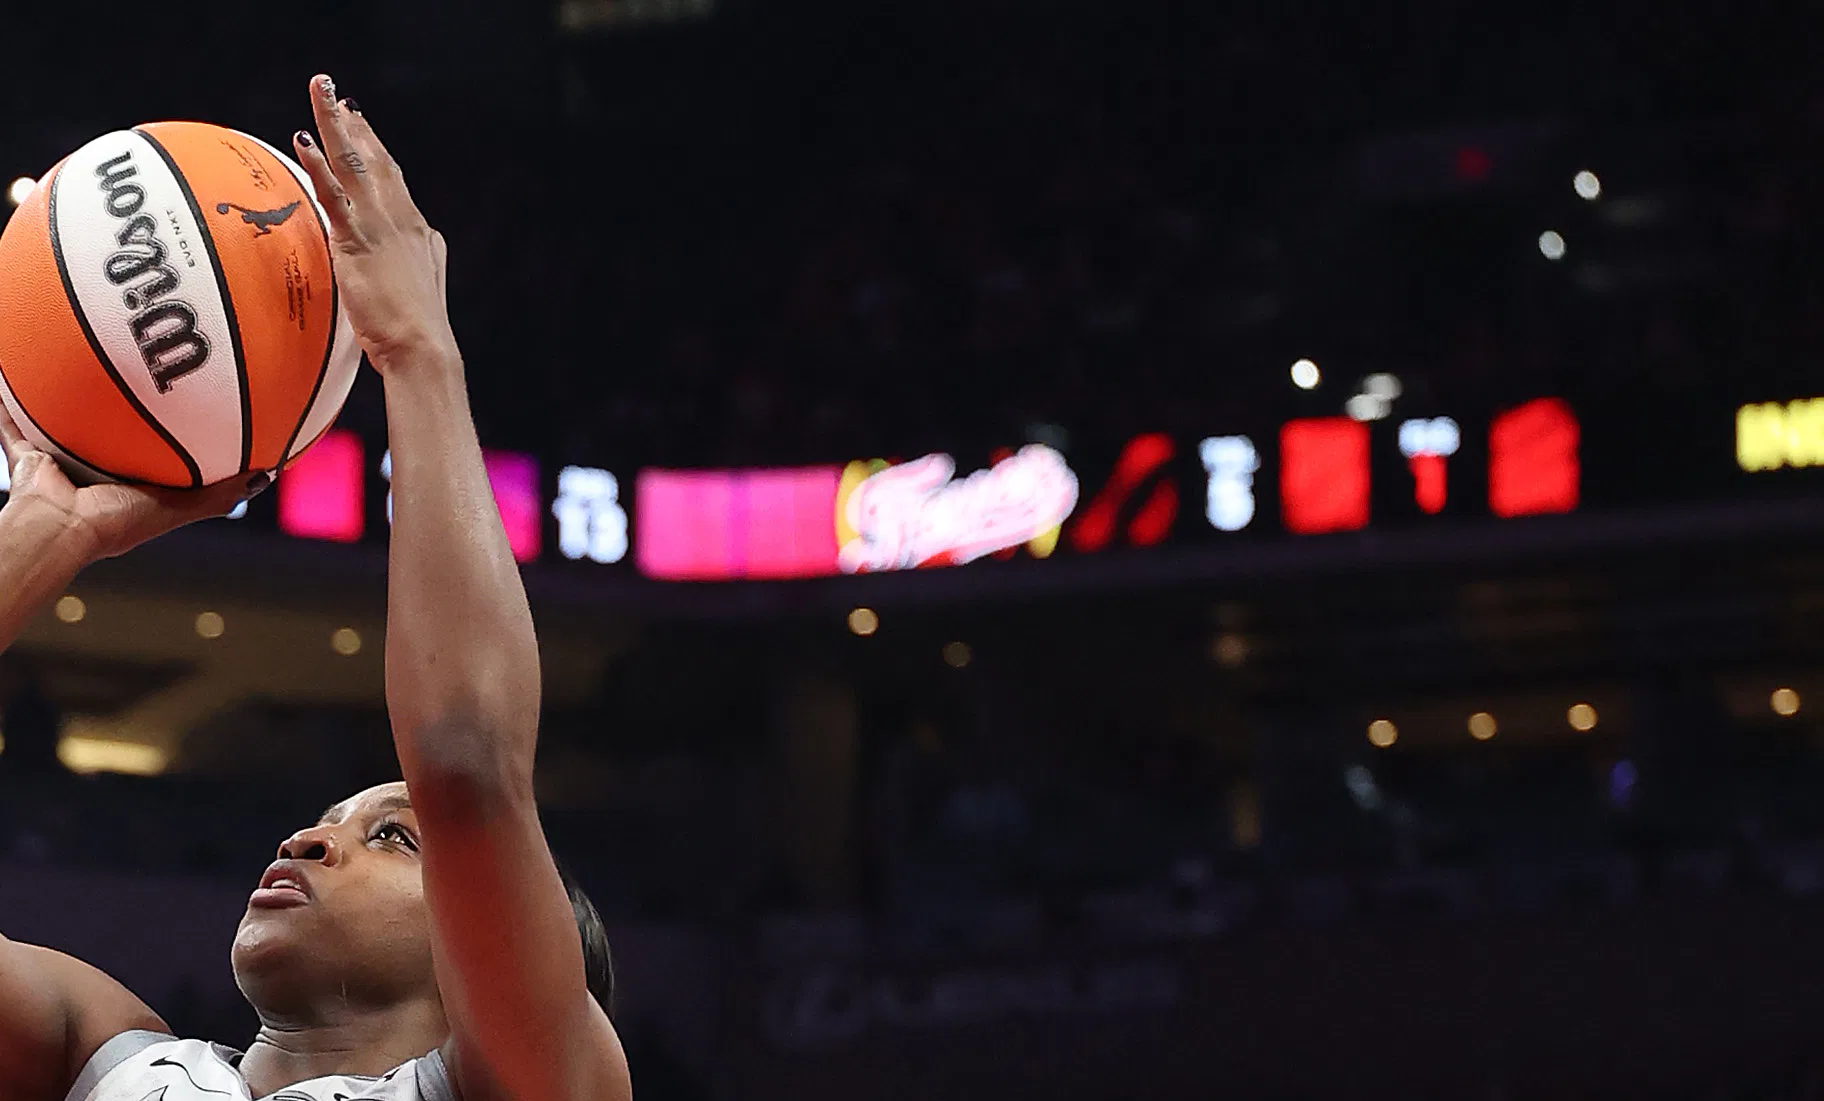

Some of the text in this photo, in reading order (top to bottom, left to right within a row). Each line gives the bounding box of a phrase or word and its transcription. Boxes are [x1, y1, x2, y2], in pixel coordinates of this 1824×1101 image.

[94, 149, 212, 396] Wilson
[165, 208, 197, 269] EVO NXT
